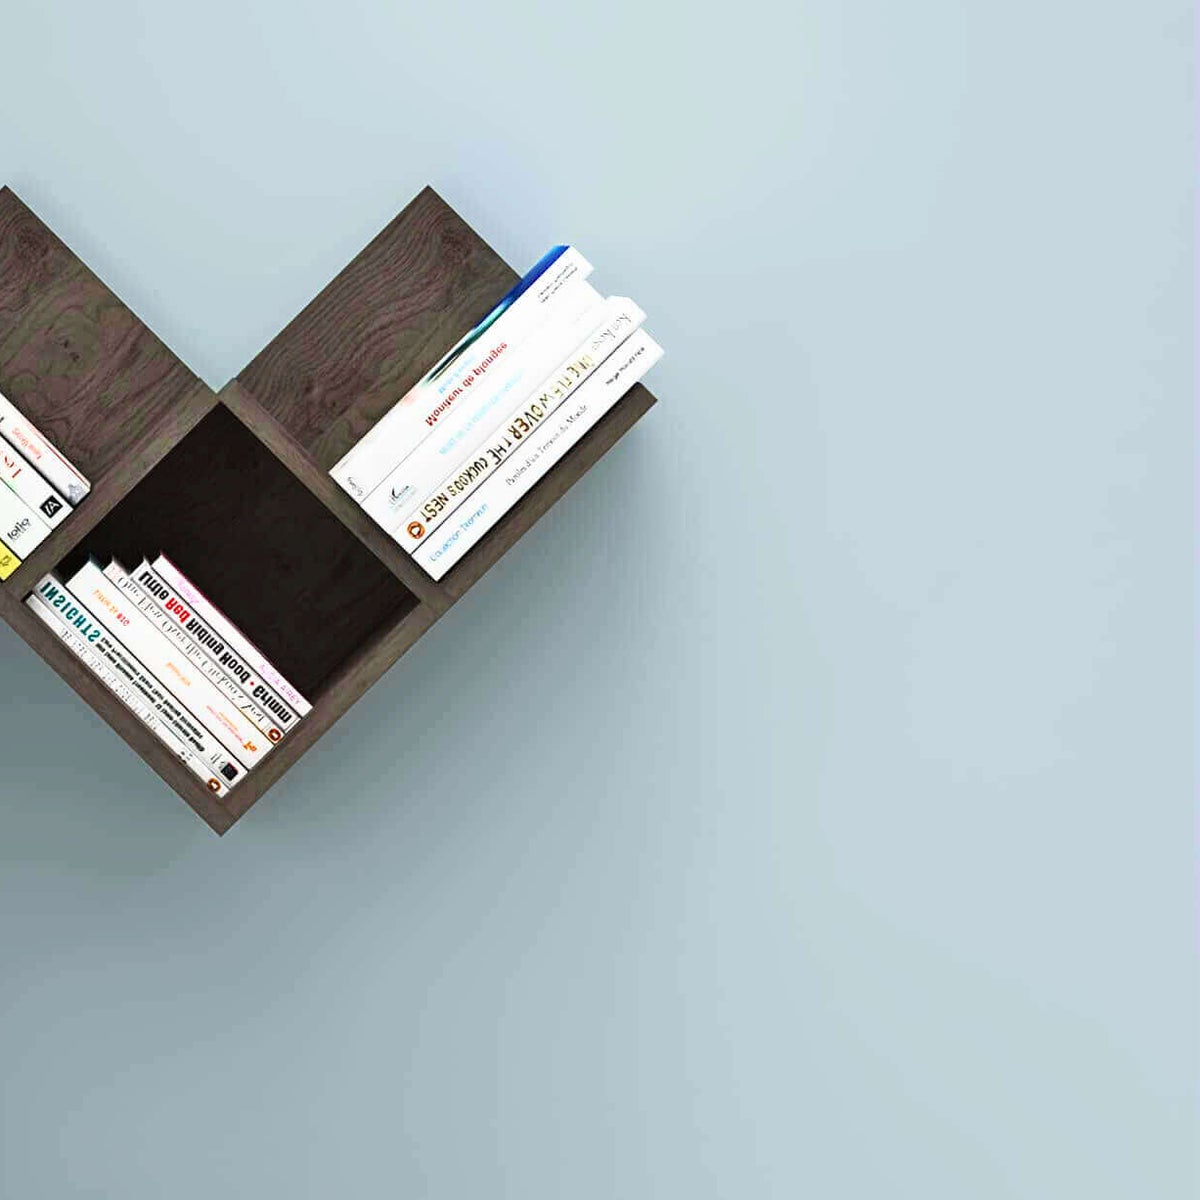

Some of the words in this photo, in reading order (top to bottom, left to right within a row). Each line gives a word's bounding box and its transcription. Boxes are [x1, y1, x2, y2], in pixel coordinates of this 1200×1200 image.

[507, 402, 544, 440] OVER
[485, 435, 514, 465] THE
[446, 455, 489, 498] CUCKOO'S
[418, 491, 450, 523] NEST
